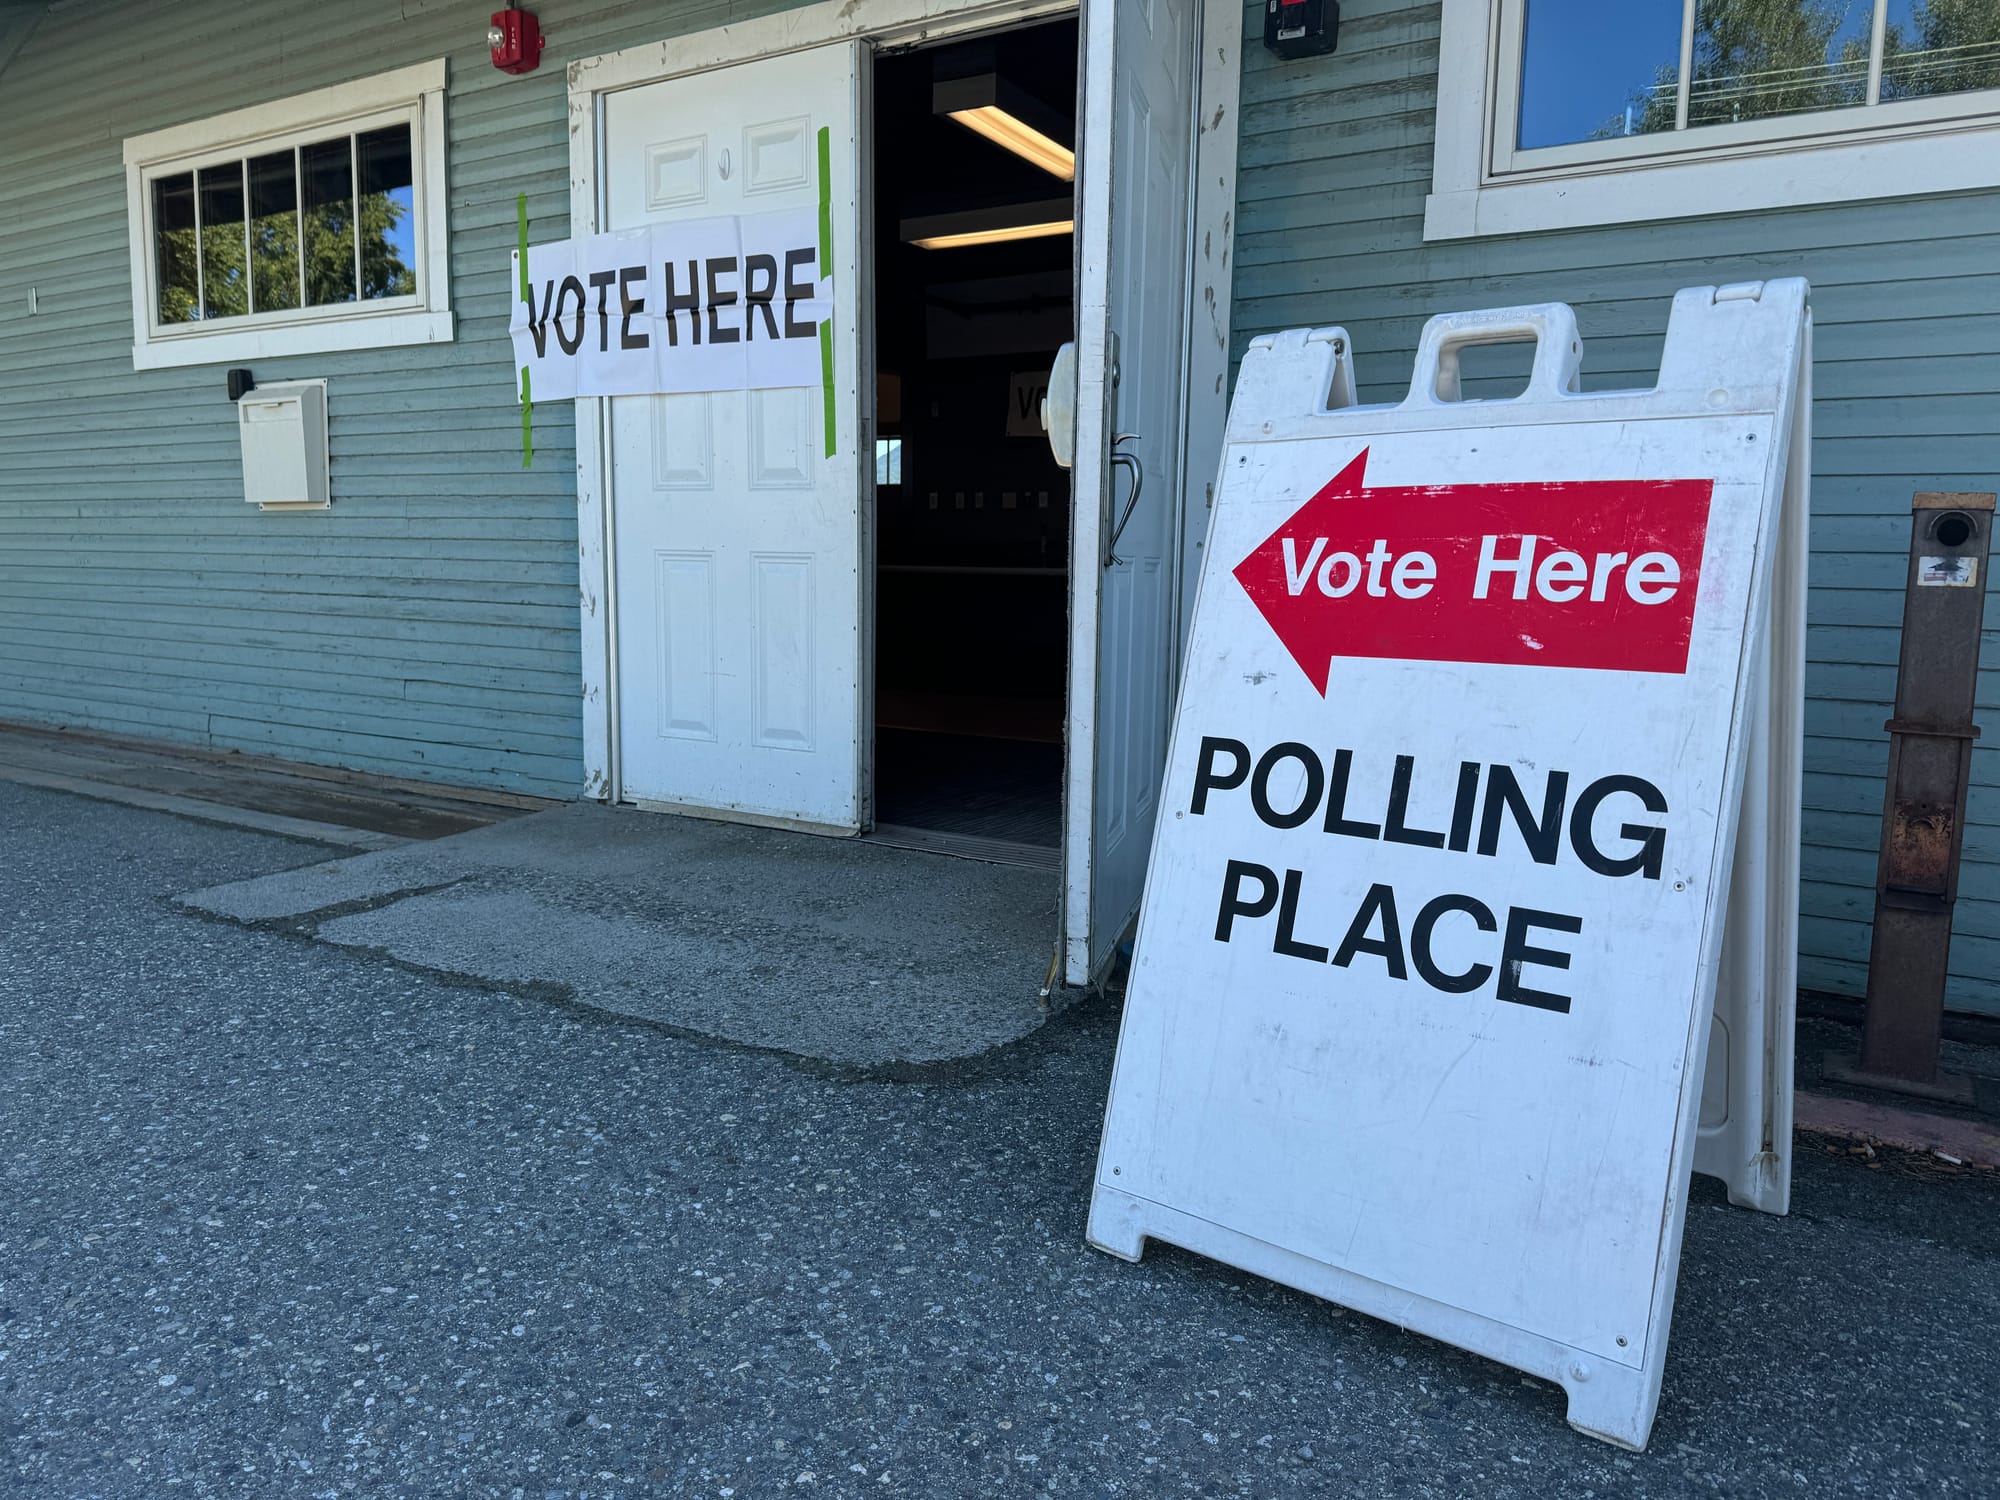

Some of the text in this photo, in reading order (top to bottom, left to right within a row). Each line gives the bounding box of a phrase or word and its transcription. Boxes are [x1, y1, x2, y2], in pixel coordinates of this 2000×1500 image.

[528, 247, 817, 358] VOTE HERE
[1281, 535, 1681, 606] Vote Here
[1189, 736, 1669, 881] POLLING
[1214, 859, 1583, 1015] PLACE
